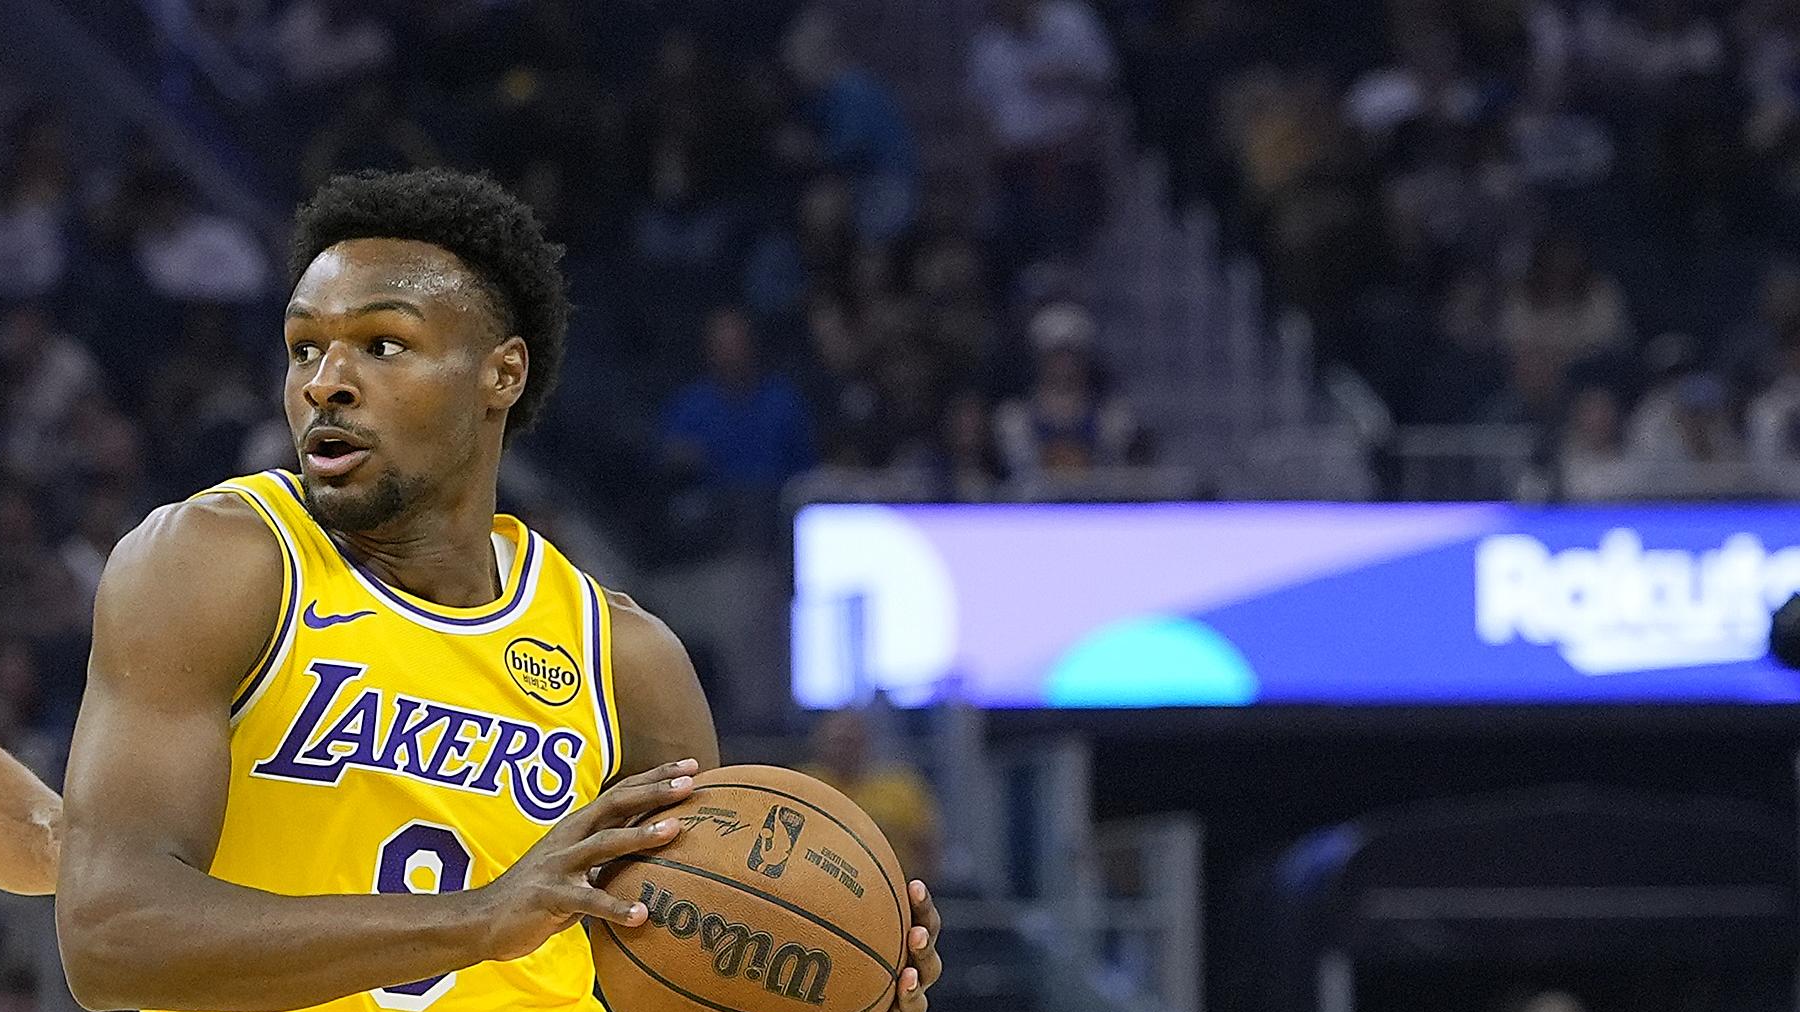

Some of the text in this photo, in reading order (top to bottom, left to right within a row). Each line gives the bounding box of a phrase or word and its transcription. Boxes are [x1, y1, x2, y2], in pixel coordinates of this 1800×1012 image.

[511, 650, 575, 690] bibigo
[249, 658, 588, 826] LAKERS
[638, 880, 832, 1005] Wilson
